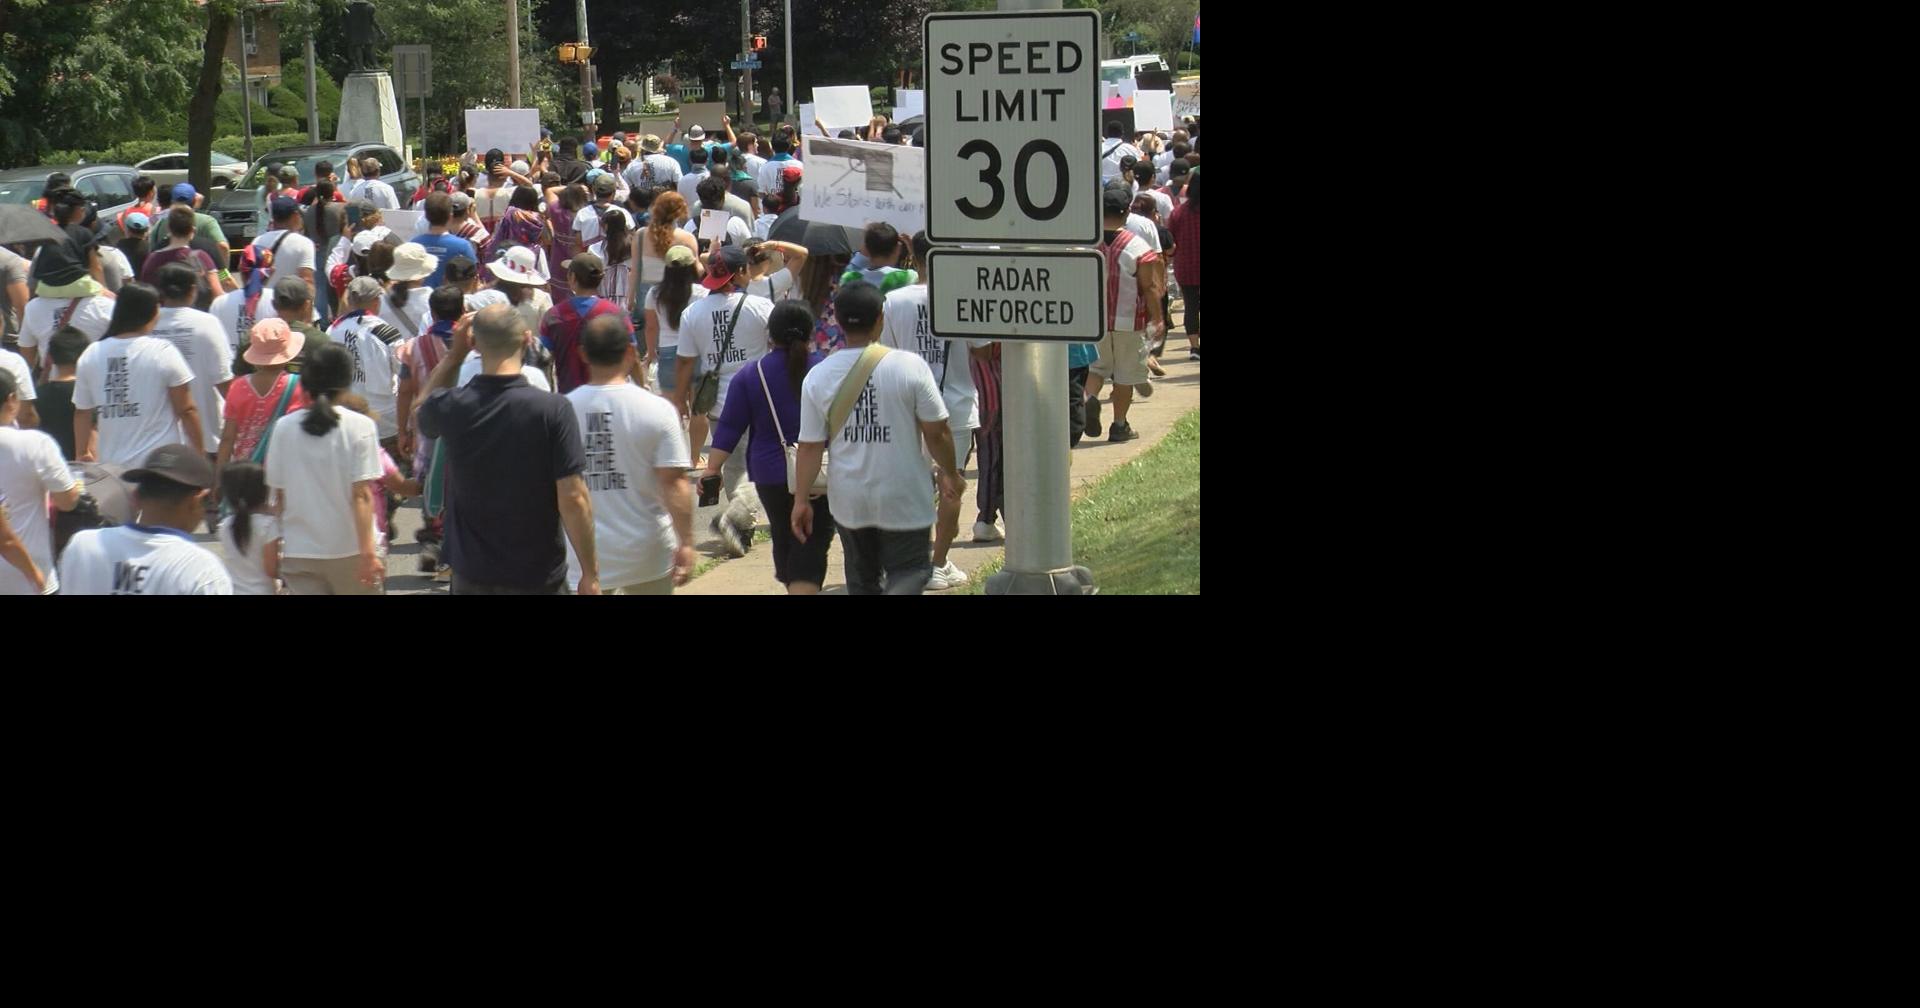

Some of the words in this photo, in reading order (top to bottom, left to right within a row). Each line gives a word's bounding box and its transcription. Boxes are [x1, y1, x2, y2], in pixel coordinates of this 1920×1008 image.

[940, 41, 1082, 75] SPEED
[956, 89, 1065, 122] LIMIT
[955, 139, 1069, 221] 30
[977, 267, 1050, 291] RADAR
[712, 310, 730, 324] WE
[957, 299, 1074, 325] ENFORCED
[916, 335, 941, 350] THE
[107, 357, 128, 372] WE
[104, 373, 128, 387] ARE
[105, 388, 128, 403] THE
[854, 407, 879, 425] THE
[844, 426, 892, 443] FUTURE
